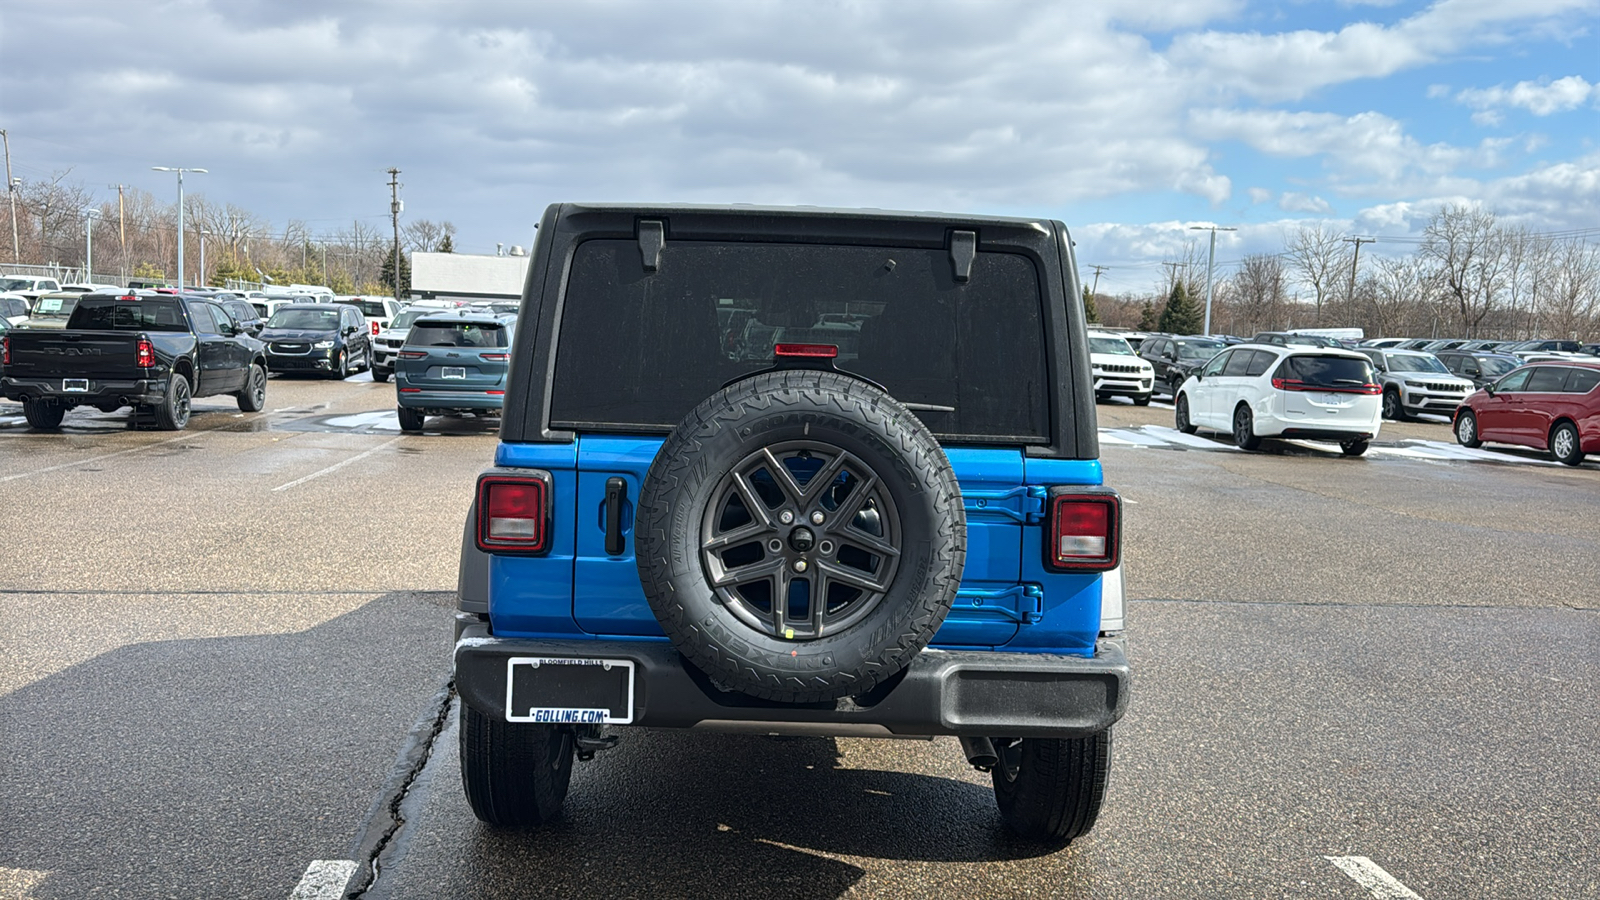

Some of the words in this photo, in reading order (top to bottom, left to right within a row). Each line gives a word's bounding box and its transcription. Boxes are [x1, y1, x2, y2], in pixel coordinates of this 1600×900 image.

[43, 347, 101, 356] RAM
[753, 413, 860, 434] ROADIAN
[673, 502, 686, 564] All-Weather
[711, 624, 821, 670] NEXEN
[535, 710, 604, 723] GOLLING.COM
